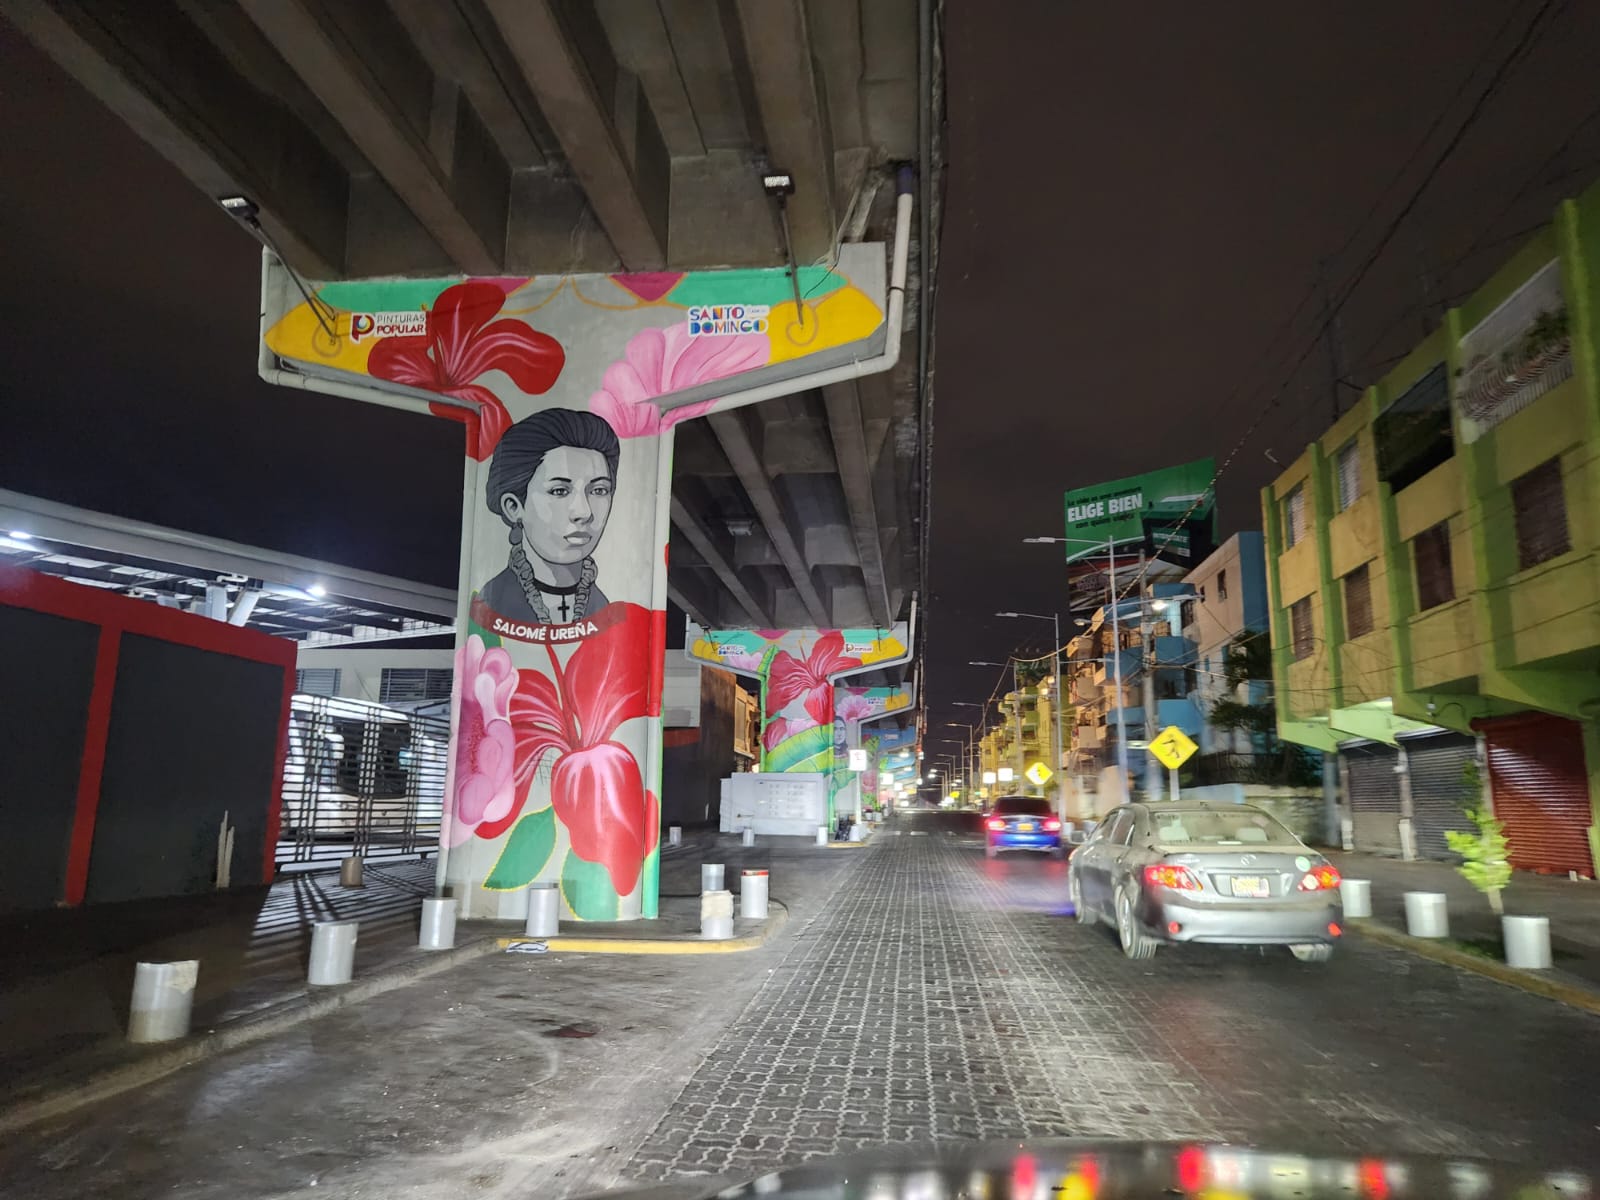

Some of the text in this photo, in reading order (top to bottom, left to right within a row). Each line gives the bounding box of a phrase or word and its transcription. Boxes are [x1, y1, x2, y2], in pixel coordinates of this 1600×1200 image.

[376, 314, 425, 324] PINTURAS
[689, 307, 745, 321] SANTO
[376, 324, 424, 335] POPULAR
[690, 320, 767, 335] DOMINGO
[1067, 492, 1143, 523] ELIGE BIEN
[492, 618, 599, 641] SALOMÉ UREÑA
